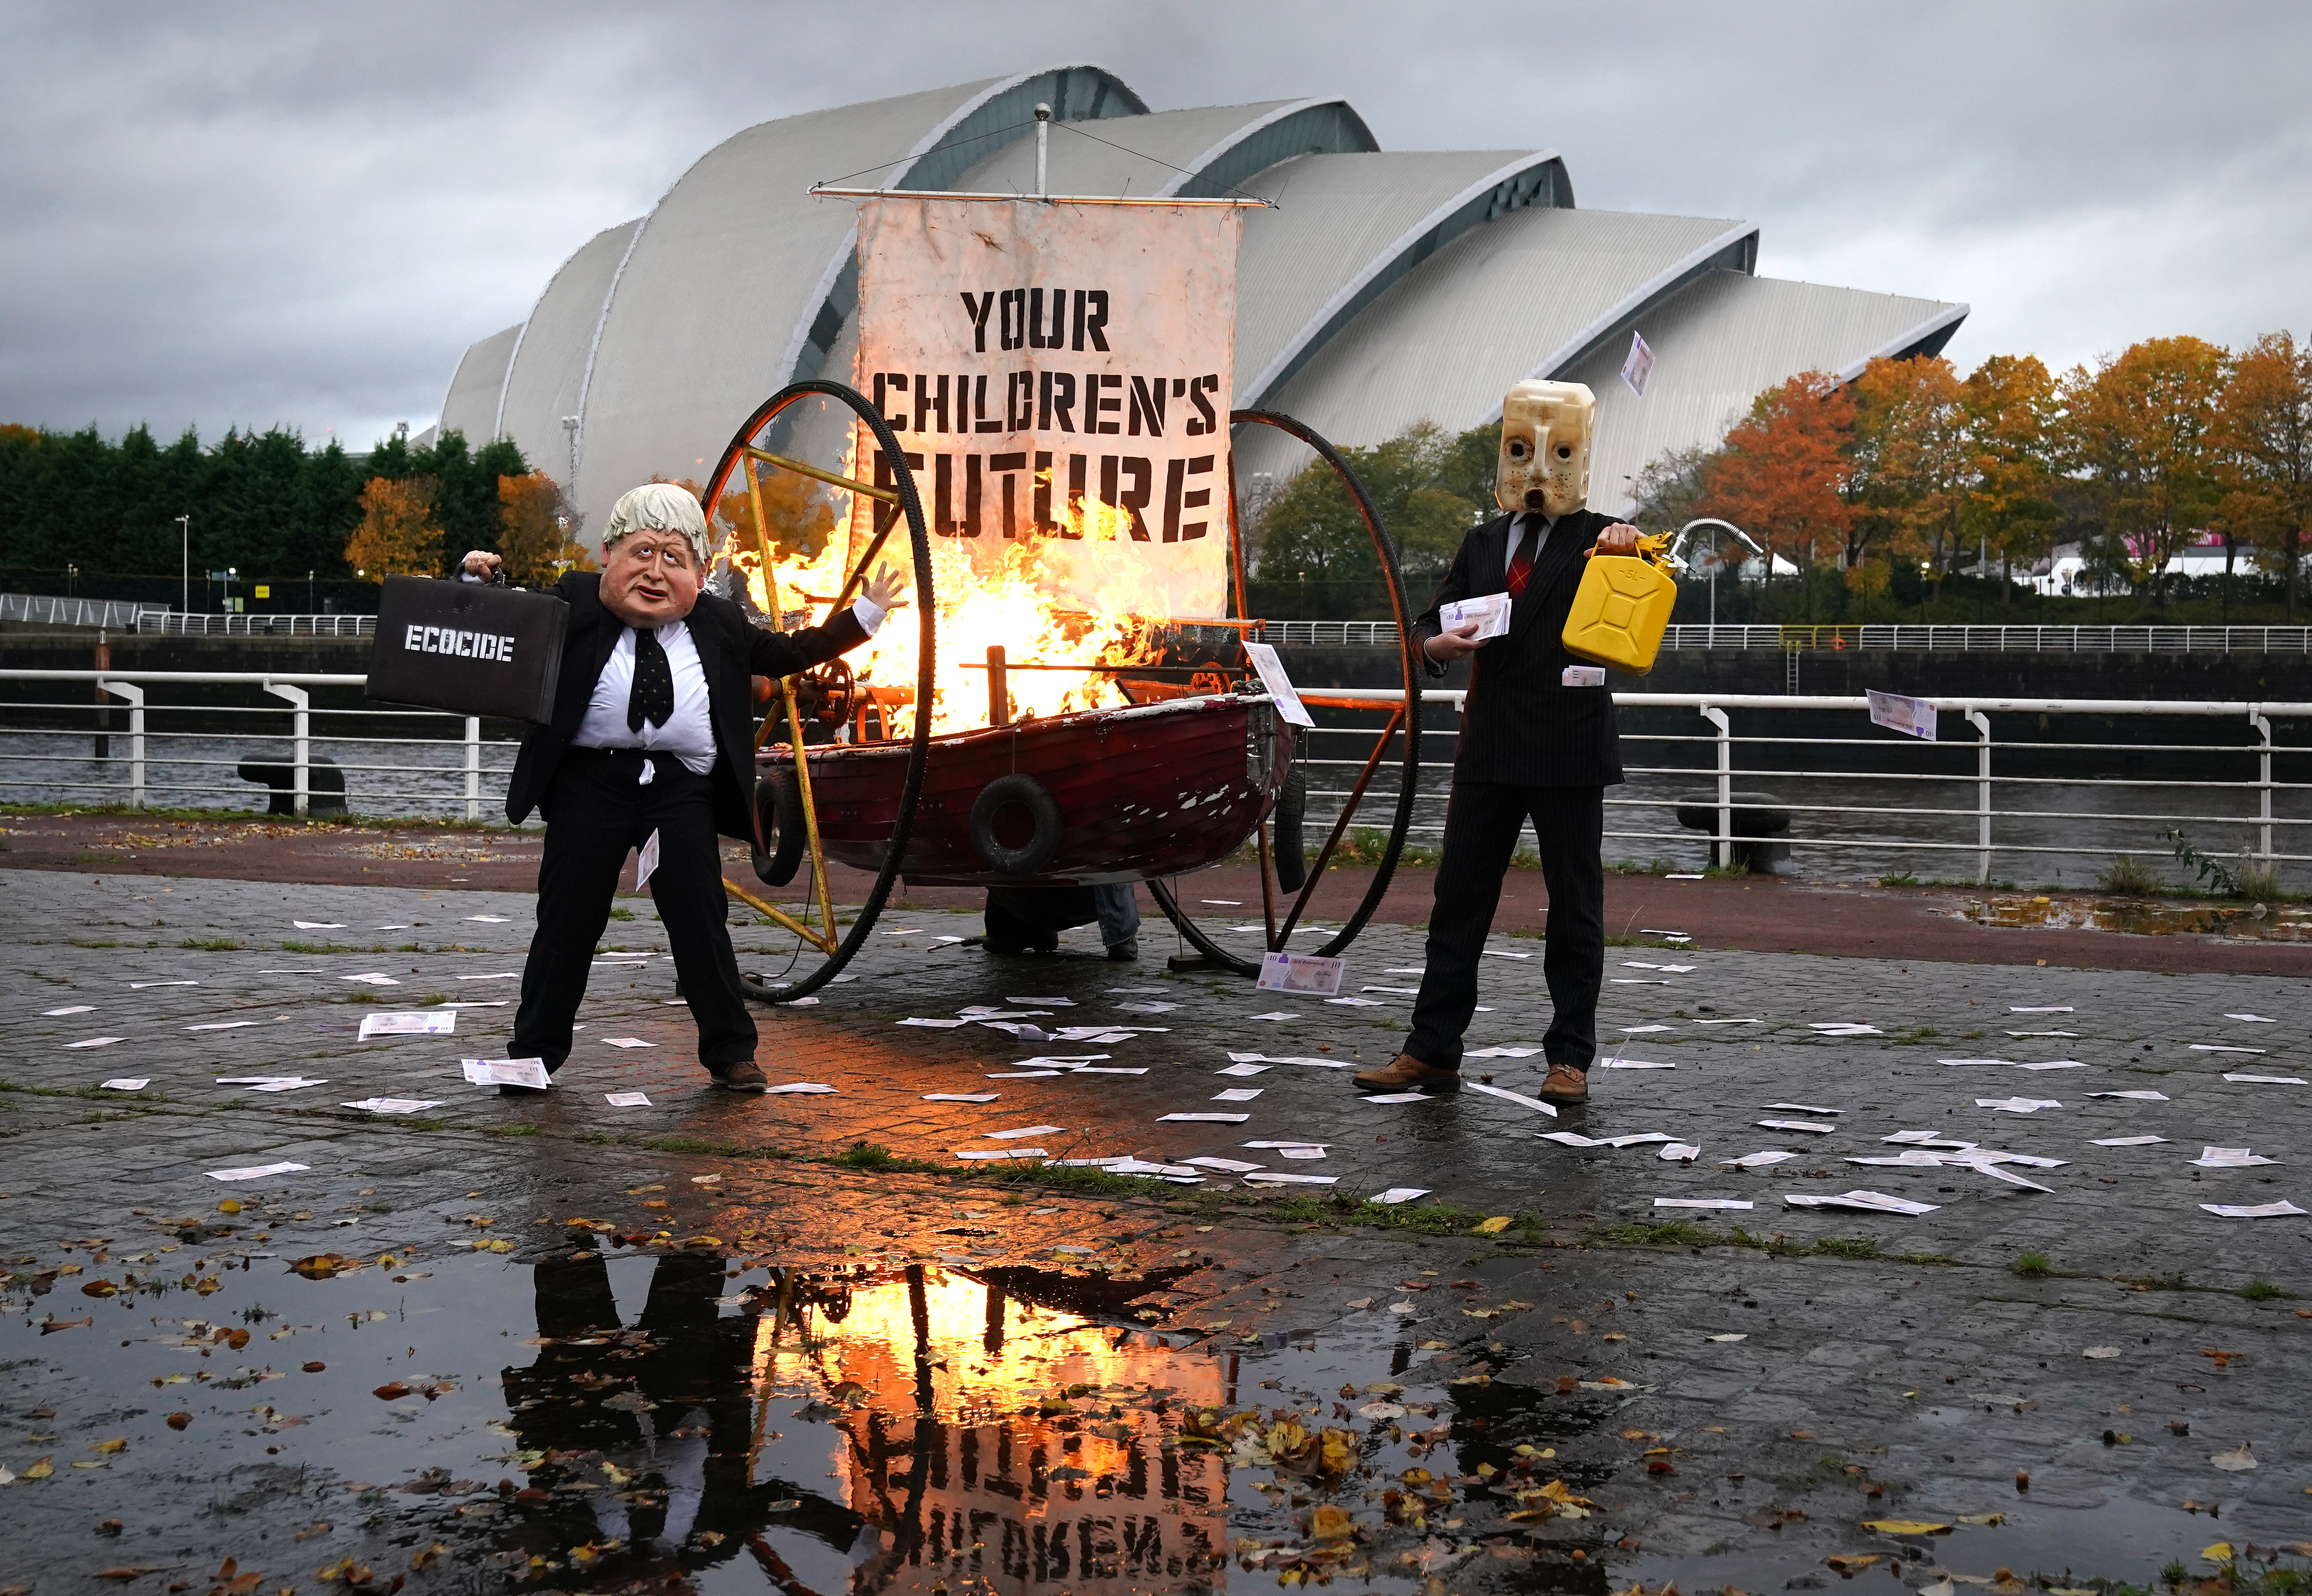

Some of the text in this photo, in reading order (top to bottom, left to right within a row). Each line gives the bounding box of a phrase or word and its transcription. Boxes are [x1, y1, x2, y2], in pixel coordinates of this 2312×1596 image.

[961, 288, 1110, 352] YOUR
[873, 370, 1218, 438] CHILDREN'S
[873, 450, 1215, 543] FUTURE
[405, 624, 515, 662] ECOCIDE
[1572, 670, 1579, 679] 10
